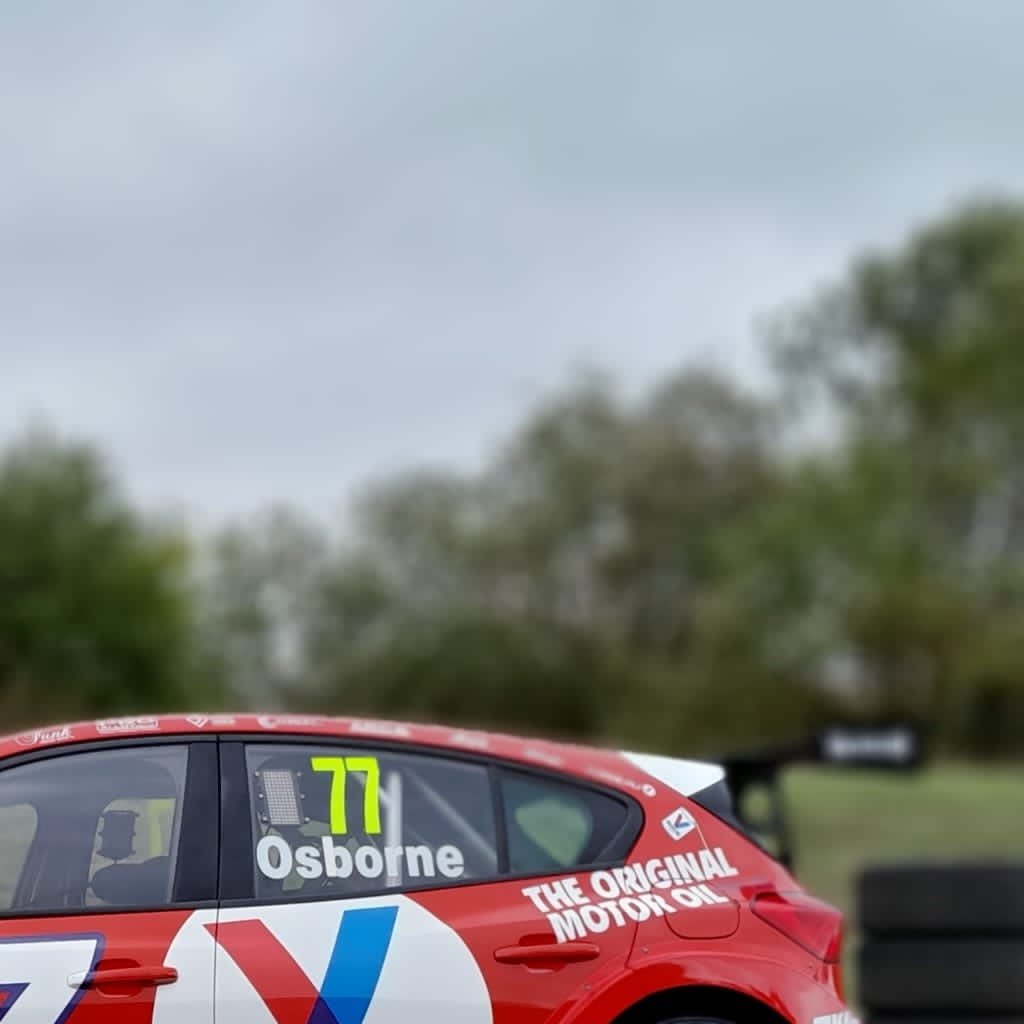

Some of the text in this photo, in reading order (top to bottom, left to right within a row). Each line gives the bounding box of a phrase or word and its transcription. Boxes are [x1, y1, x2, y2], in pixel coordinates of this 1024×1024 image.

[310, 757, 382, 834] 77
[256, 835, 465, 880] Osborne
[521, 847, 739, 913] THE ORIGINAL
[546, 884, 729, 944] MOTOR OIL
